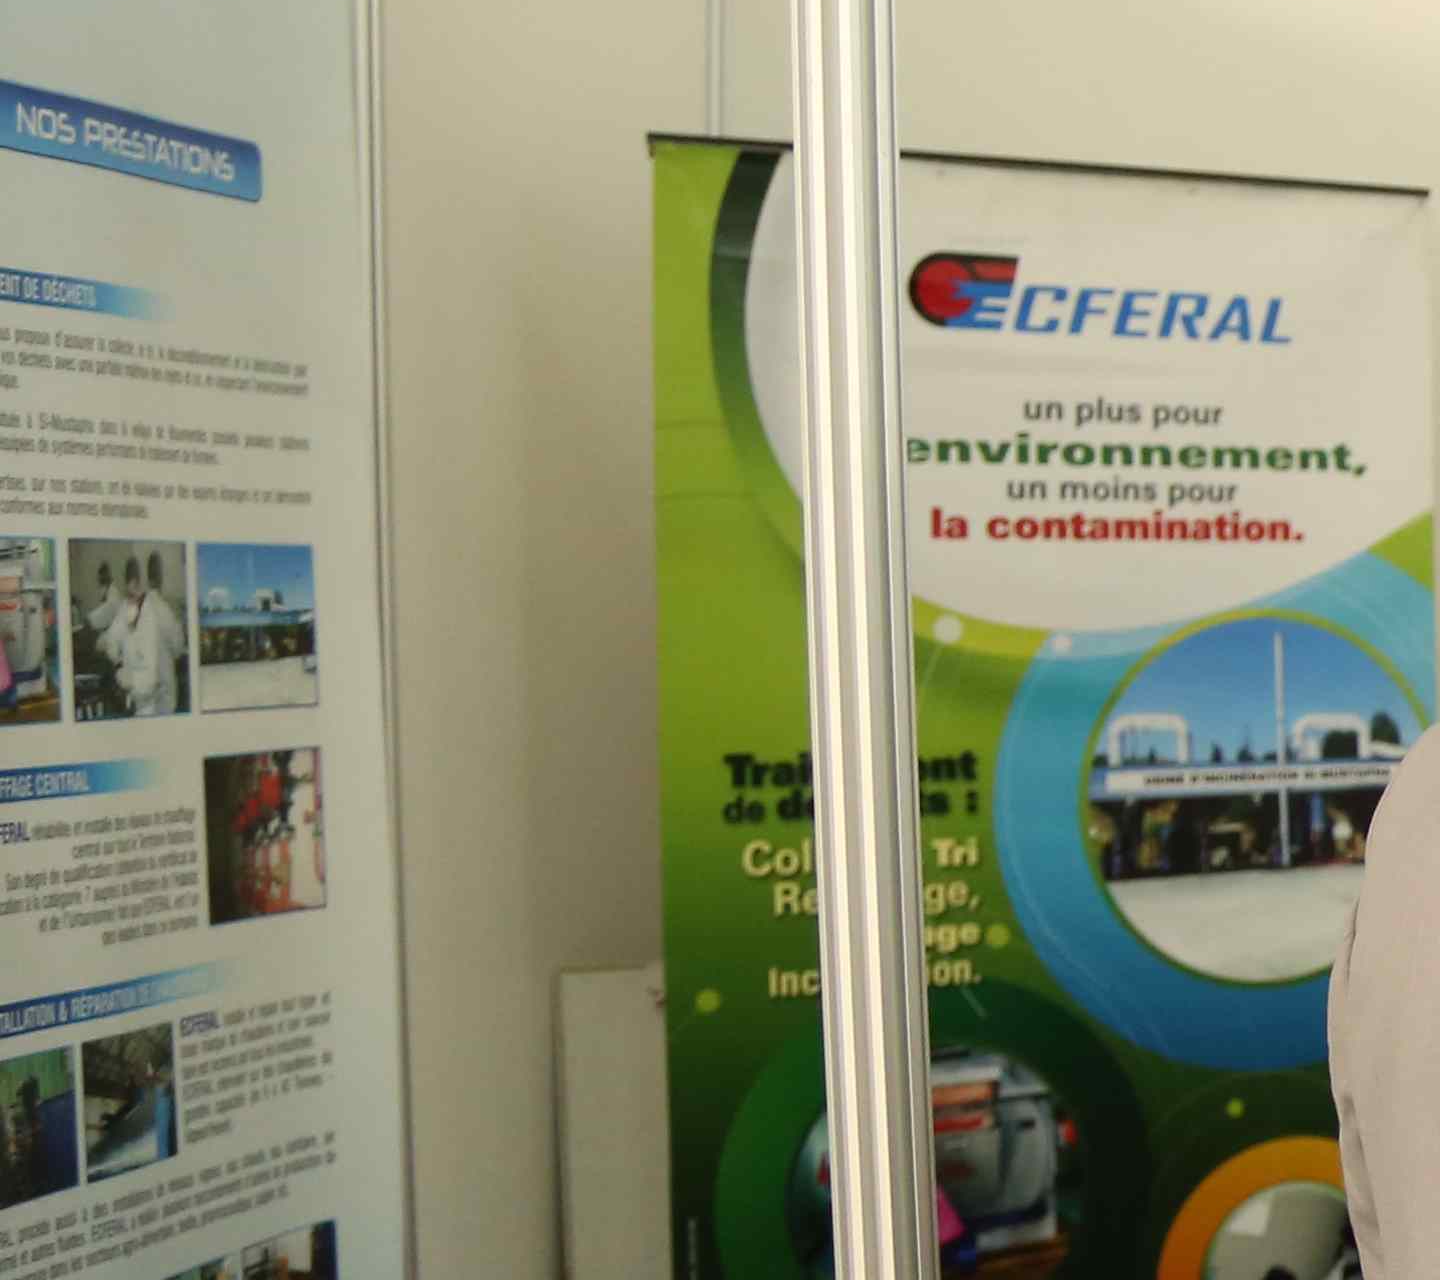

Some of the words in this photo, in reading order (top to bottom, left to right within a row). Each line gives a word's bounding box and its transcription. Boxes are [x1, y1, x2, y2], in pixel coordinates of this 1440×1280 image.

[16, 102, 76, 146] NOS
[938, 272, 1293, 345] ECFERAL
[1023, 399, 1063, 422] un
[1074, 396, 1142, 428] plus
[1152, 402, 1223, 429] pour
[906, 432, 1367, 478] environnement,
[1006, 480, 1048, 502] un
[1059, 475, 1158, 503] moins
[1167, 482, 1238, 507] pour
[930, 506, 968, 540] la
[986, 509, 1304, 543] contamination.
[723, 795, 765, 824] de
[932, 836, 981, 868] Tri
